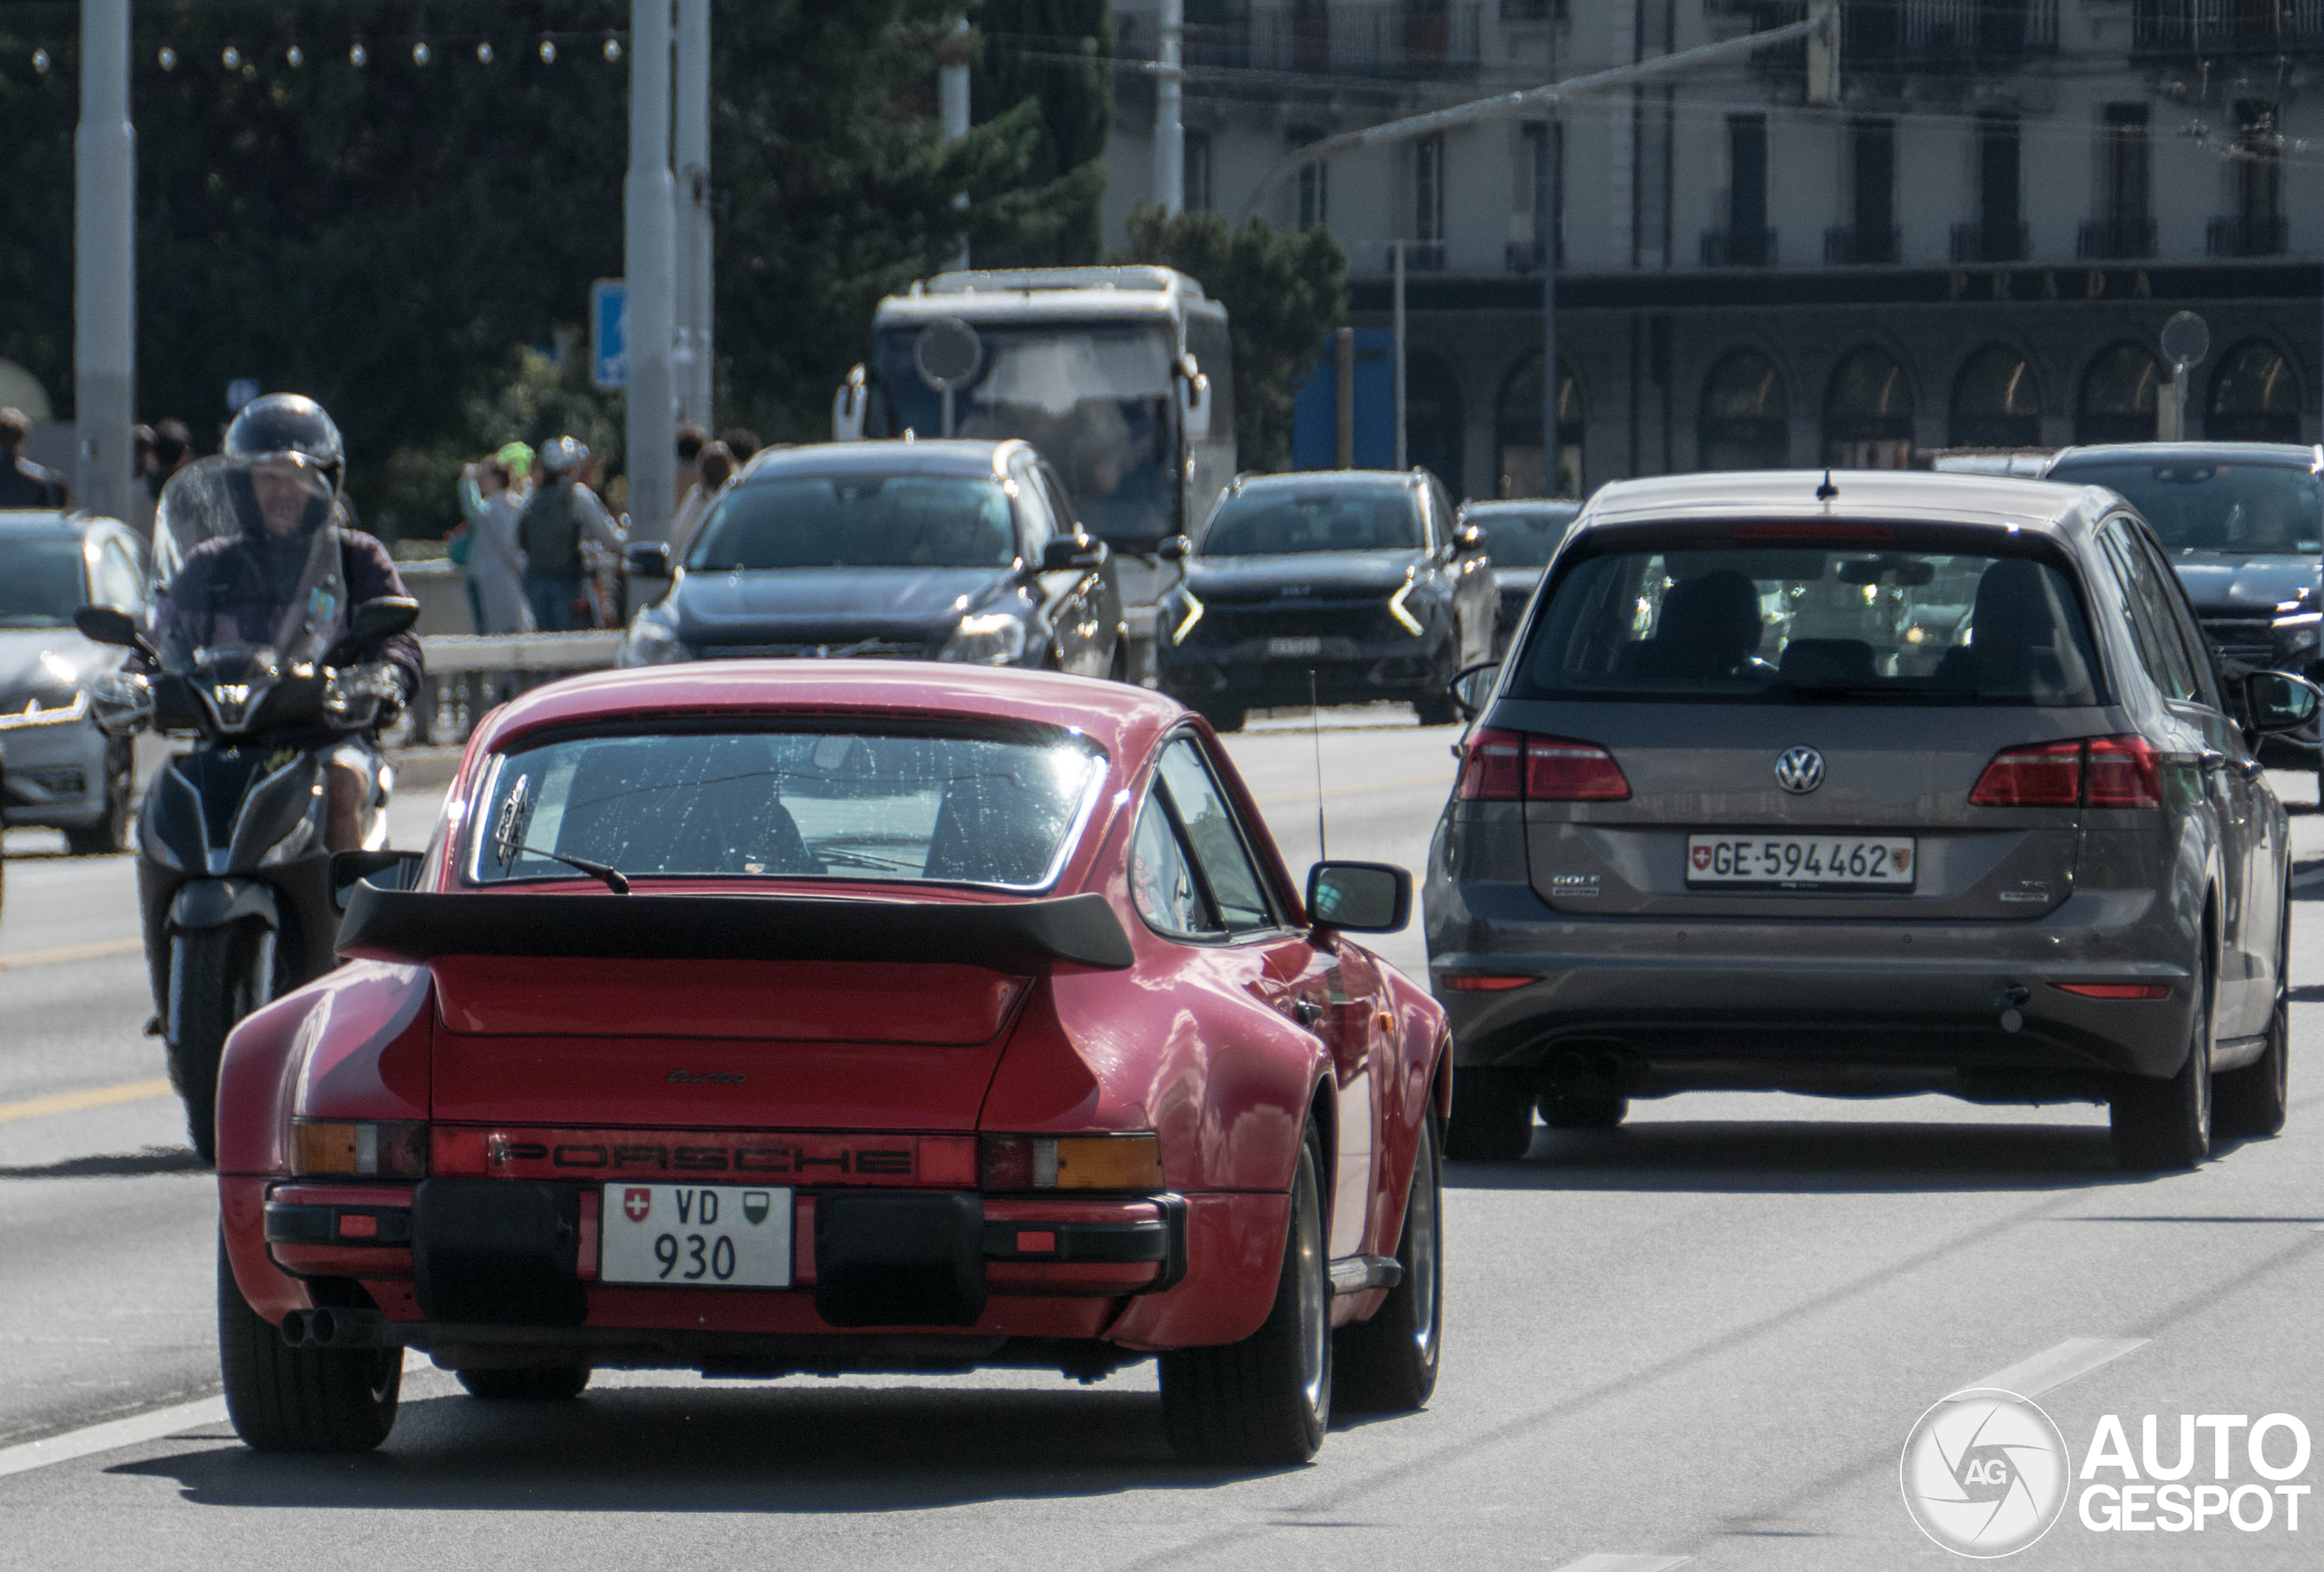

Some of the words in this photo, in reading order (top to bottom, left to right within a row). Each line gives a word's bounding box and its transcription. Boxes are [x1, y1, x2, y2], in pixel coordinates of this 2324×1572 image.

[1951, 270, 2152, 300] PRADA
[1777, 746, 1823, 792] VW
[493, 1143, 911, 1174] PORSCHE
[675, 1189, 719, 1225] VD
[654, 1233, 736, 1280] 930
